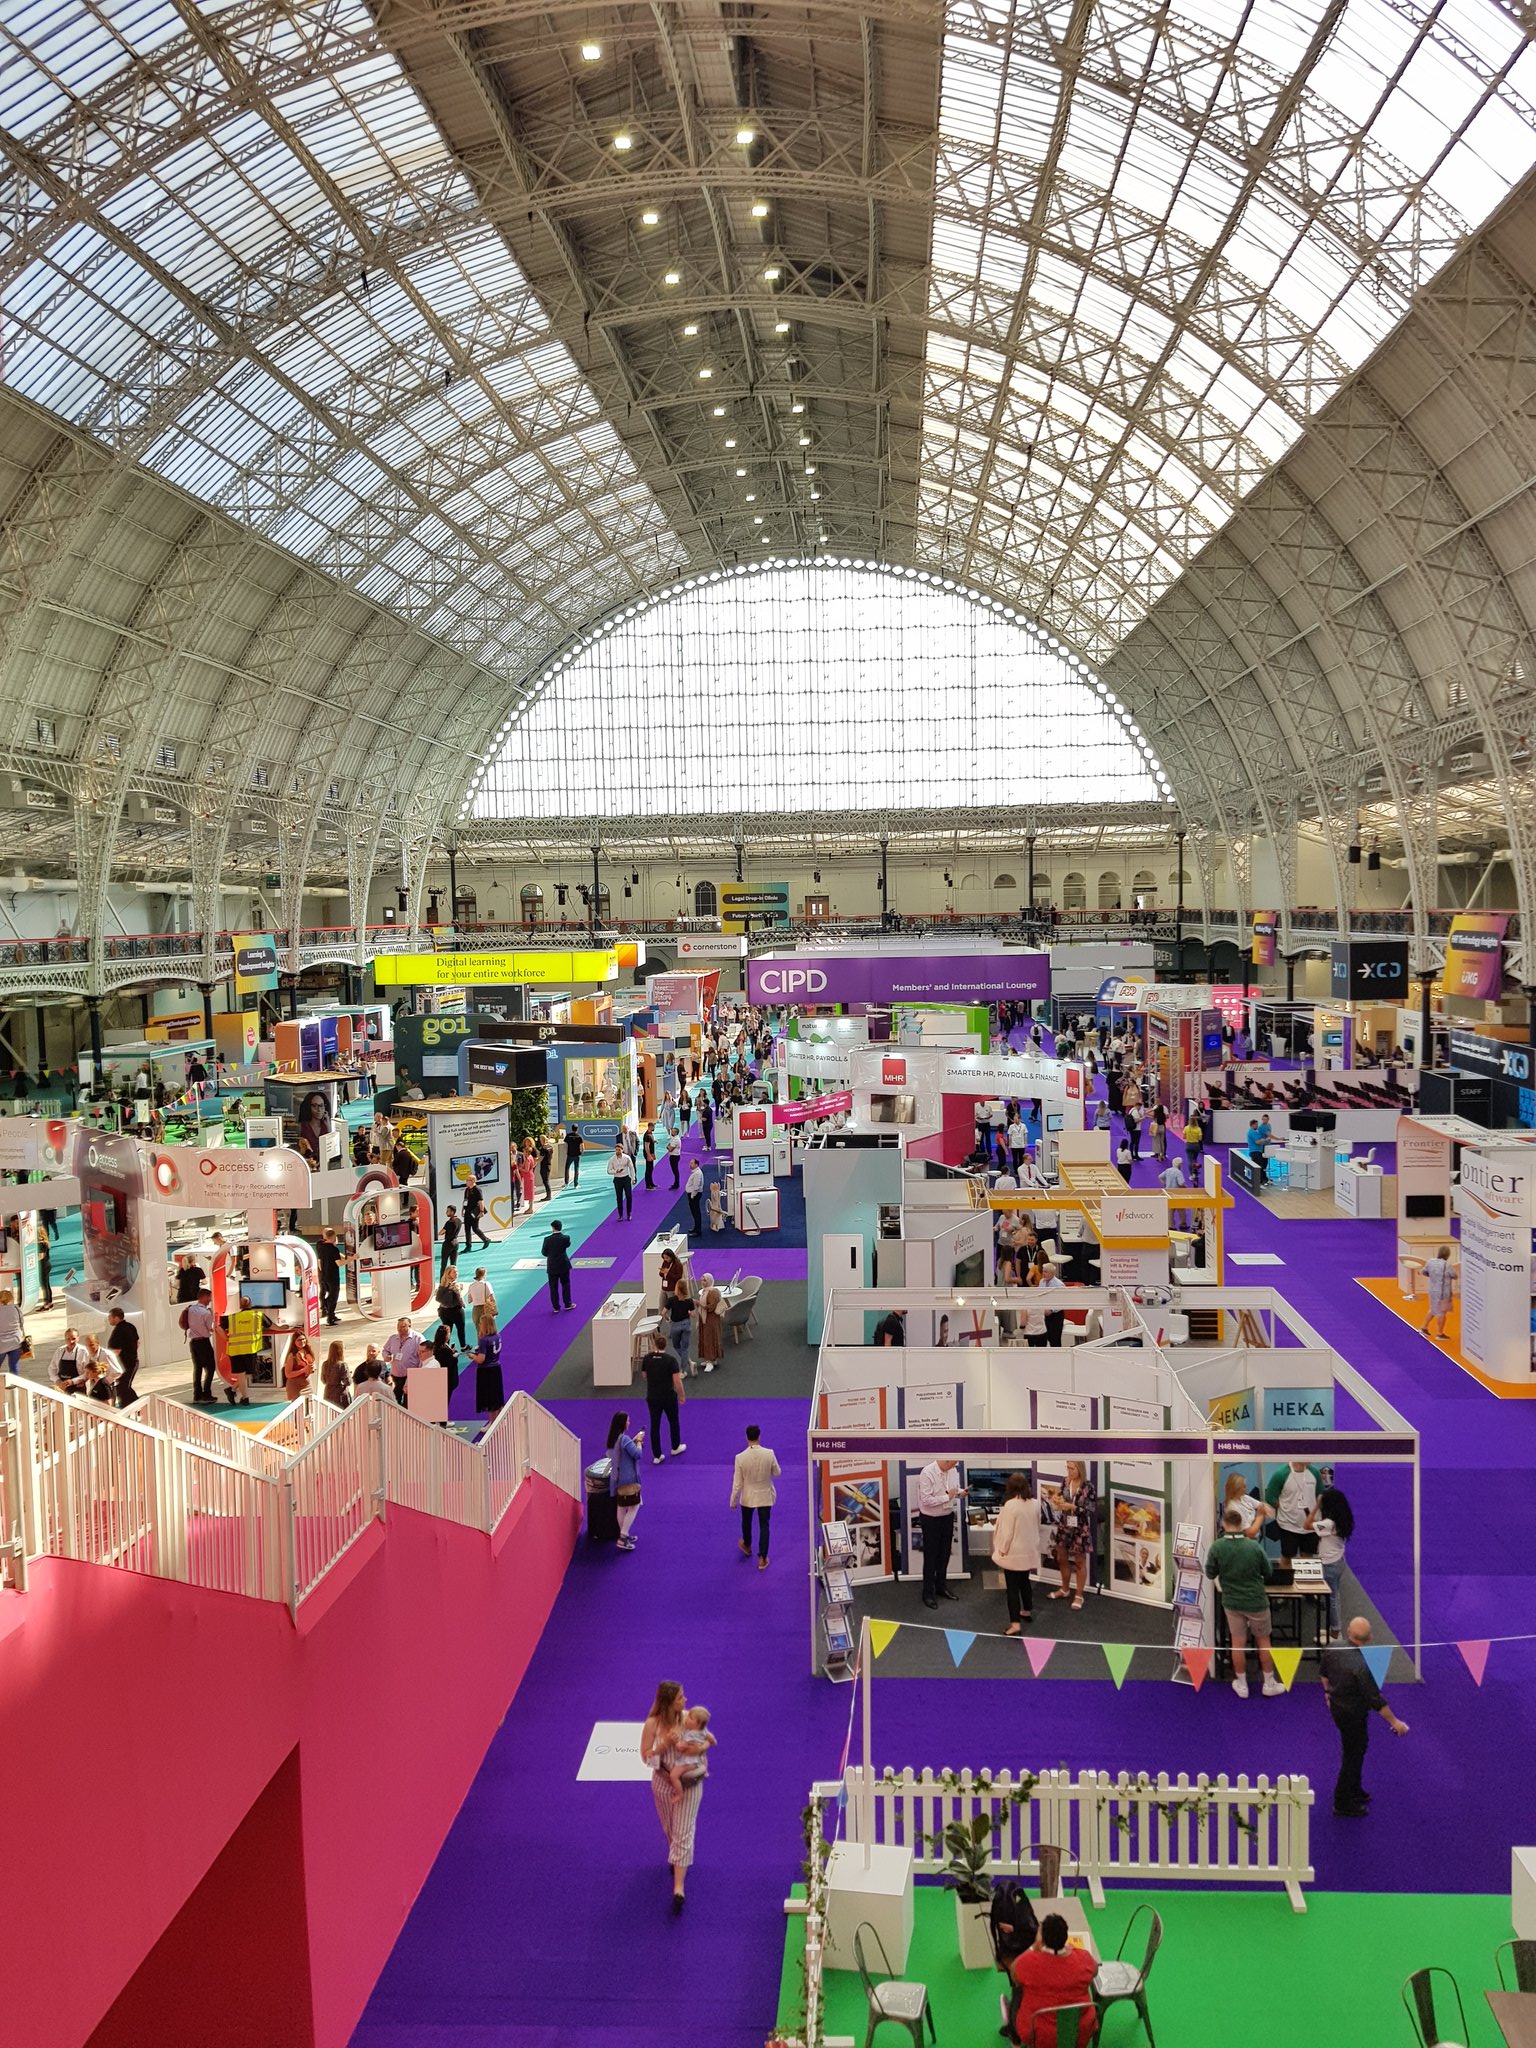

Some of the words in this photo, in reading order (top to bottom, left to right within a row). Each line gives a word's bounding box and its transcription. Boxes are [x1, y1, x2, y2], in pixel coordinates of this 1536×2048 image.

[247, 950, 262, 959] Learning
[1153, 949, 1173, 961] TREET
[238, 962, 262, 970] Development
[436, 957, 467, 967] Digital
[469, 957, 506, 967] learning
[436, 970, 450, 979] for
[451, 971, 473, 981] your
[473, 969, 500, 978] entire
[501, 968, 546, 978] workforce
[1461, 971, 1479, 985] UKG
[759, 969, 828, 993] CIPD
[951, 982, 1004, 991] International
[1006, 981, 1037, 991] Lounge
[422, 1015, 471, 1045] go1
[538, 1027, 557, 1040] go1
[495, 1063, 506, 1074] SAP
[884, 1074, 904, 1082] MHR
[946, 1068, 982, 1077] SMARTER
[982, 1070, 996, 1079] HR,
[996, 1071, 1029, 1080] PAYROLL
[1029, 1072, 1035, 1080] &
[1035, 1073, 1060, 1083] FINANCE
[1066, 1085, 1079, 1095] MHR
[1460, 1088, 1482, 1096] STAFF
[3, 1129, 29, 1138] People
[741, 1128, 764, 1137] MHR
[1402, 1139, 1446, 1148] Frontier
[98, 1154, 118, 1168] access
[219, 1163, 255, 1172] access
[256, 1161, 293, 1173] Peple
[1461, 1162, 1525, 1194] ontier
[223, 1191, 248, 1199] Learning
[252, 1191, 289, 1199] Engagement
[1124, 1212, 1154, 1222] sdworx
[1273, 1402, 1325, 1416] HEKA
[1218, 1404, 1251, 1426] HEKA
